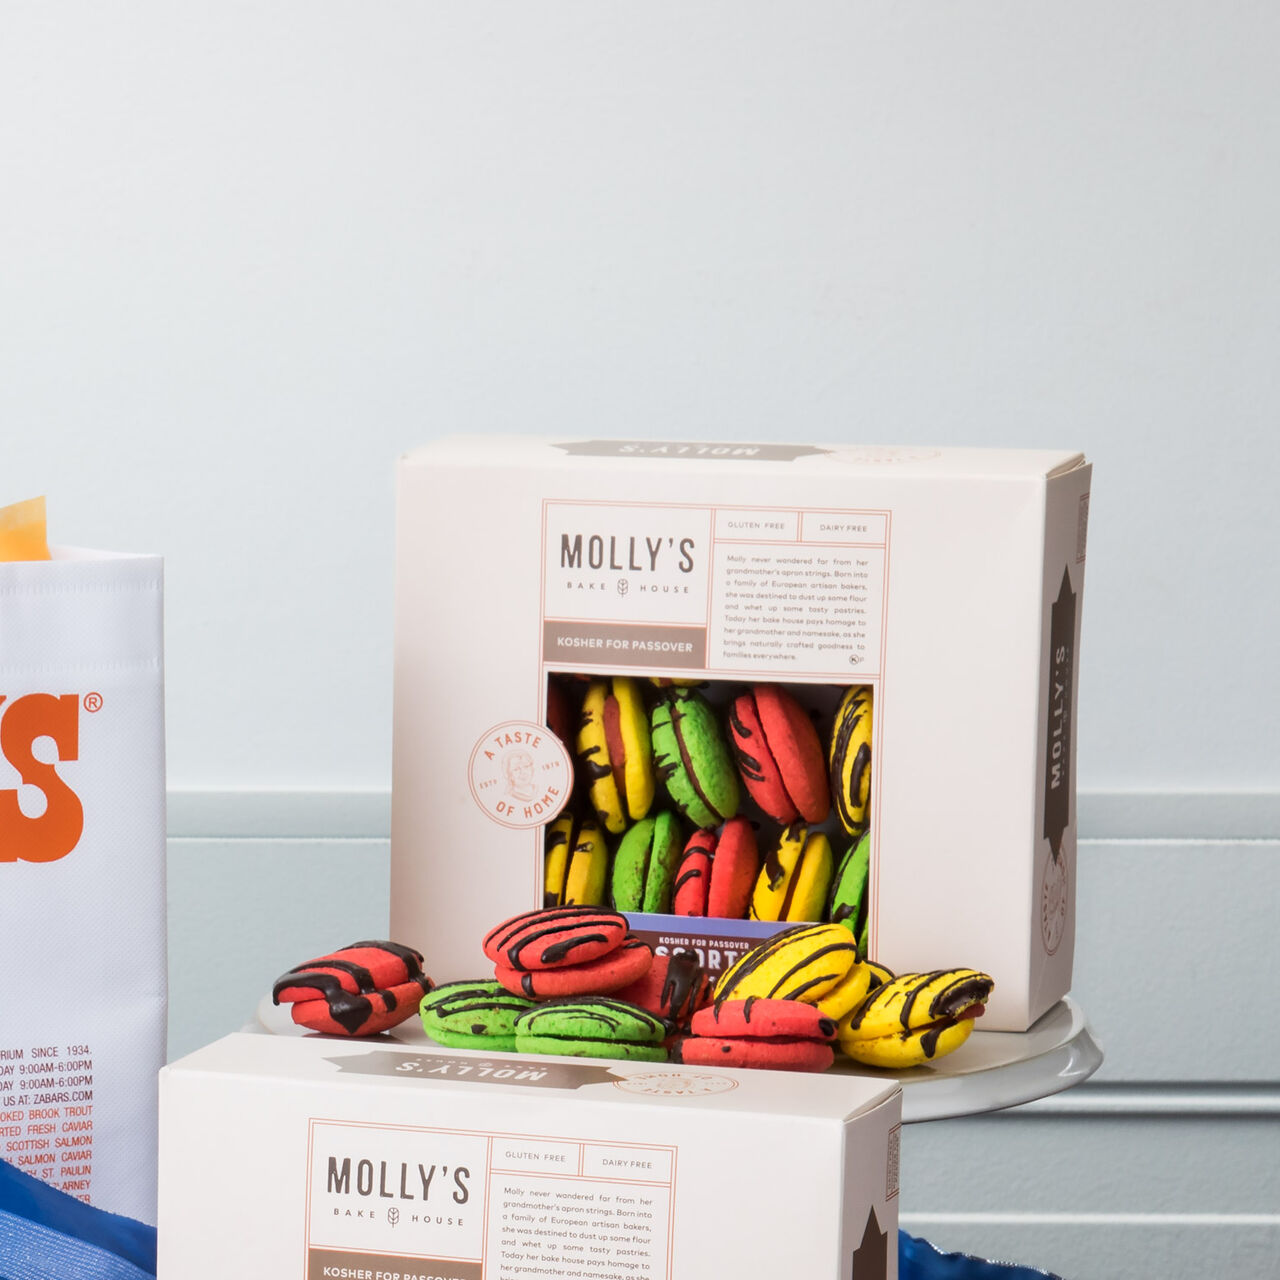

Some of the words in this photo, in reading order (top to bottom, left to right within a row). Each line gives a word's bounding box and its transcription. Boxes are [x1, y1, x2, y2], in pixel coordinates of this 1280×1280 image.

[728, 521, 760, 529] GLUTEN
[820, 524, 844, 532] DAIRY
[561, 534, 695, 573] MOLLY'S
[567, 581, 606, 590] BAKE
[640, 585, 688, 594] HOUSE
[557, 636, 603, 648] KOSHER
[606, 639, 630, 650] FOR
[632, 640, 693, 653] PASSOVER
[1051, 646, 1065, 789] MOLLY'S
[484, 750, 495, 760] A
[494, 731, 541, 749] TASTE
[496, 801, 515, 816] OF
[524, 786, 559, 818] HOME
[658, 936, 689, 946] KOSHER
[691, 938, 706, 947] FOR
[709, 940, 750, 950] PASSOVER
[30, 1046, 58, 1059] SINCE
[66, 1043, 92, 1057] 1934.
[18, 1058, 93, 1075] 9:00AM-6:00PM
[395, 1061, 549, 1081] MOLLY'S
[19, 1074, 93, 1091] 9:00AM-6:00PM
[2, 1095, 16, 1107] US
[17, 1094, 30, 1106] AT:
[33, 1089, 94, 1105] ZABARS.COM
[27, 1107, 60, 1121] BROOK
[63, 1104, 94, 1118] TROUT
[505, 1151, 540, 1160] GLUTEN
[544, 1154, 566, 1162] FREE
[602, 1158, 629, 1167] DAIRY
[630, 1161, 653, 1169] FREE
[327, 1156, 471, 1205] MOLLY'S
[504, 1187, 525, 1196] Molly
[530, 1190, 550, 1198] never
[616, 1196, 635, 1204] from
[639, 1197, 652, 1205] her
[333, 1208, 375, 1219] BAKE
[411, 1215, 464, 1226] HOUSE
[503, 1201, 560, 1211] grandmother's
[586, 1207, 615, 1216] strings.
[616, 1208, 635, 1217] Born
[637, 1210, 652, 1219] into
[511, 1213, 536, 1223] family
[551, 1216, 588, 1226] European
[592, 1220, 620, 1229] artisan
[623, 1223, 652, 1232] bakers,
[323, 1266, 373, 1280] KOSHER
